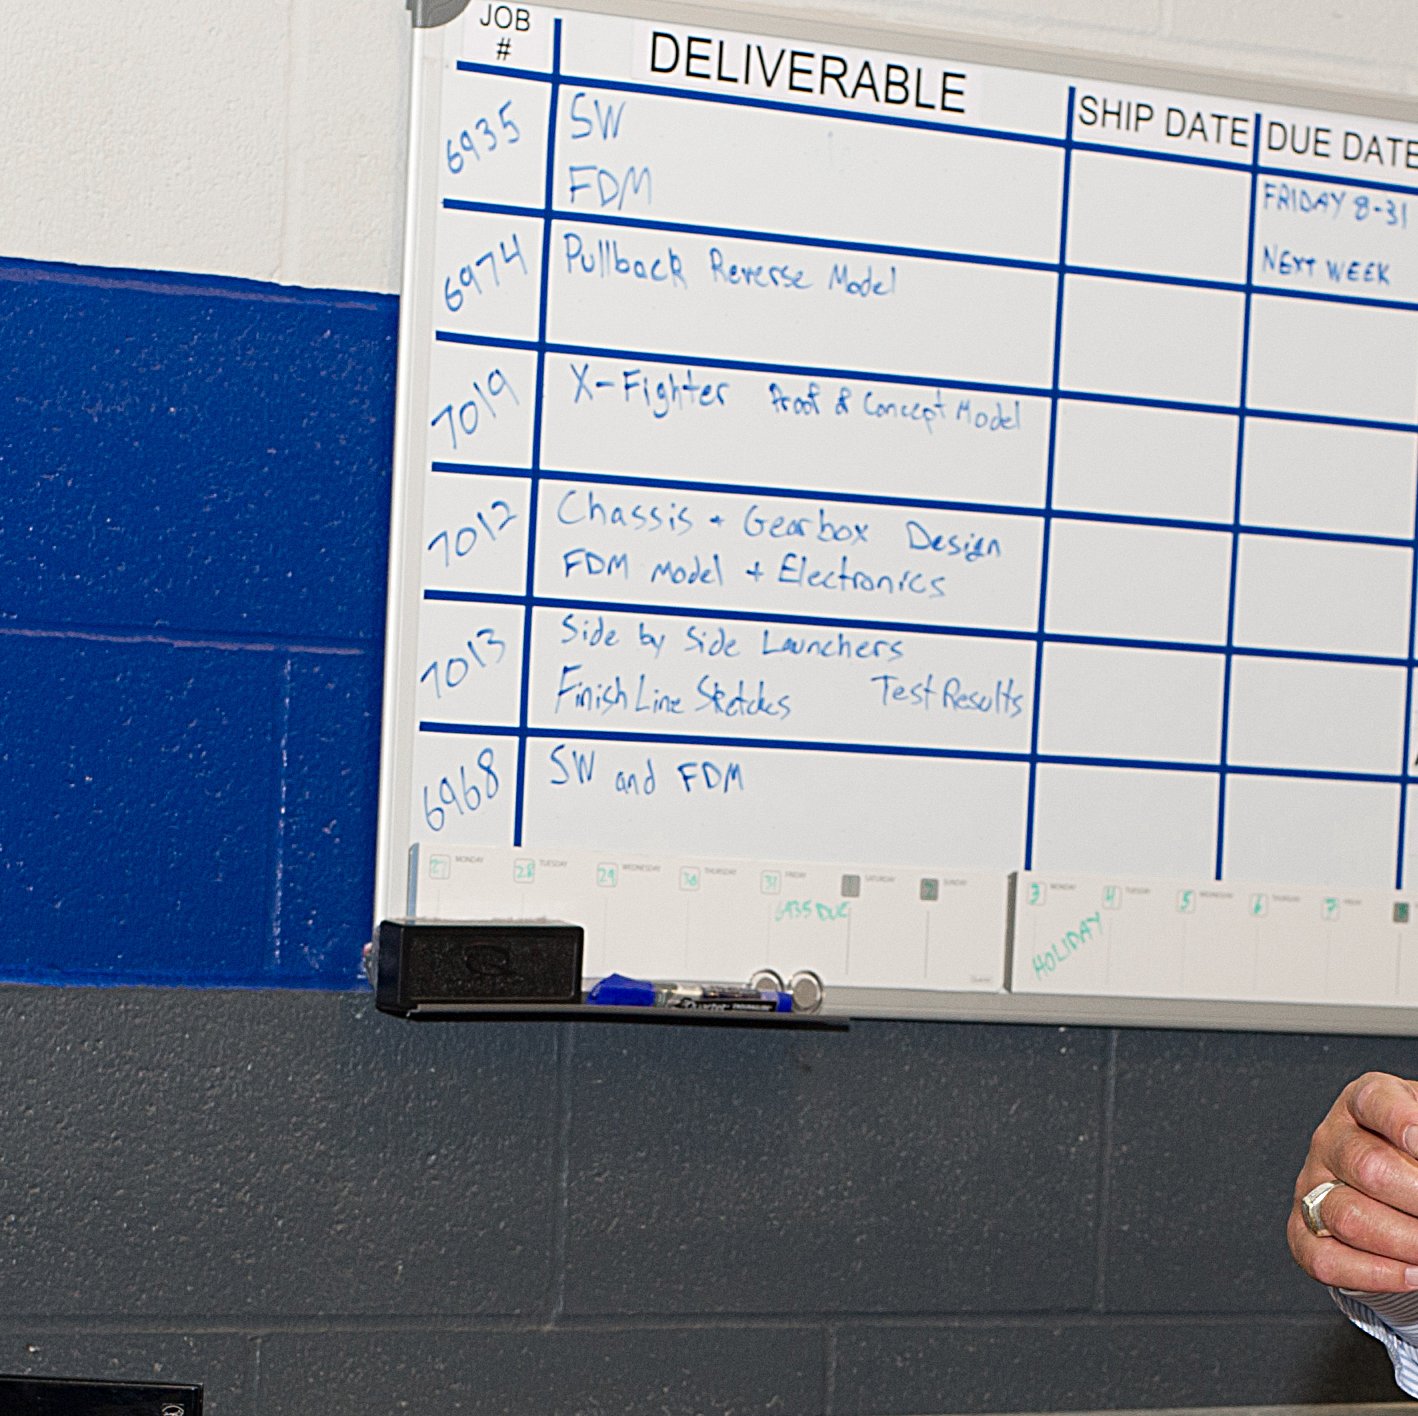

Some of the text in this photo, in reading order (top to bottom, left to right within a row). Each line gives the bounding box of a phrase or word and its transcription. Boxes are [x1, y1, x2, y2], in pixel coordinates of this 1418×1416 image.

[480, 4, 530, 31] JOB
[496, 38, 511, 60] #
[650, 31, 967, 114] DELIVERABLE
[445, 100, 521, 176] 6935
[569, 92, 627, 141] SW
[1078, 96, 1249, 148] SHIP DATE
[1267, 121, 1330, 158] DUE
[569, 165, 652, 211] FDM
[1262, 182, 1407, 229] FRIDAY 8-31
[443, 233, 527, 313] 6974
[711, 248, 813, 291] Reverse
[828, 265, 897, 298] Model
[1325, 260, 1391, 286] WEEK
[431, 369, 520, 451] 7019
[571, 363, 733, 422] X-Fighter
[862, 389, 947, 433] Concept
[957, 399, 1024, 433] Model
[428, 500, 518, 568] 7012
[556, 491, 1002, 563] Chassis Gearbox Design
[563, 548, 629, 581] FDM
[778, 554, 948, 599] Electronics
[420, 627, 506, 700] 7013
[559, 614, 620, 647] Side
[638, 621, 667, 659] by
[761, 630, 904, 661] Launchers
[870, 674, 939, 709] Test
[942, 678, 1024, 719] Results
[422, 748, 500, 833] 6968
[549, 744, 745, 797] SW and FDM
[1031, 910, 1104, 981] HOLIDAY
